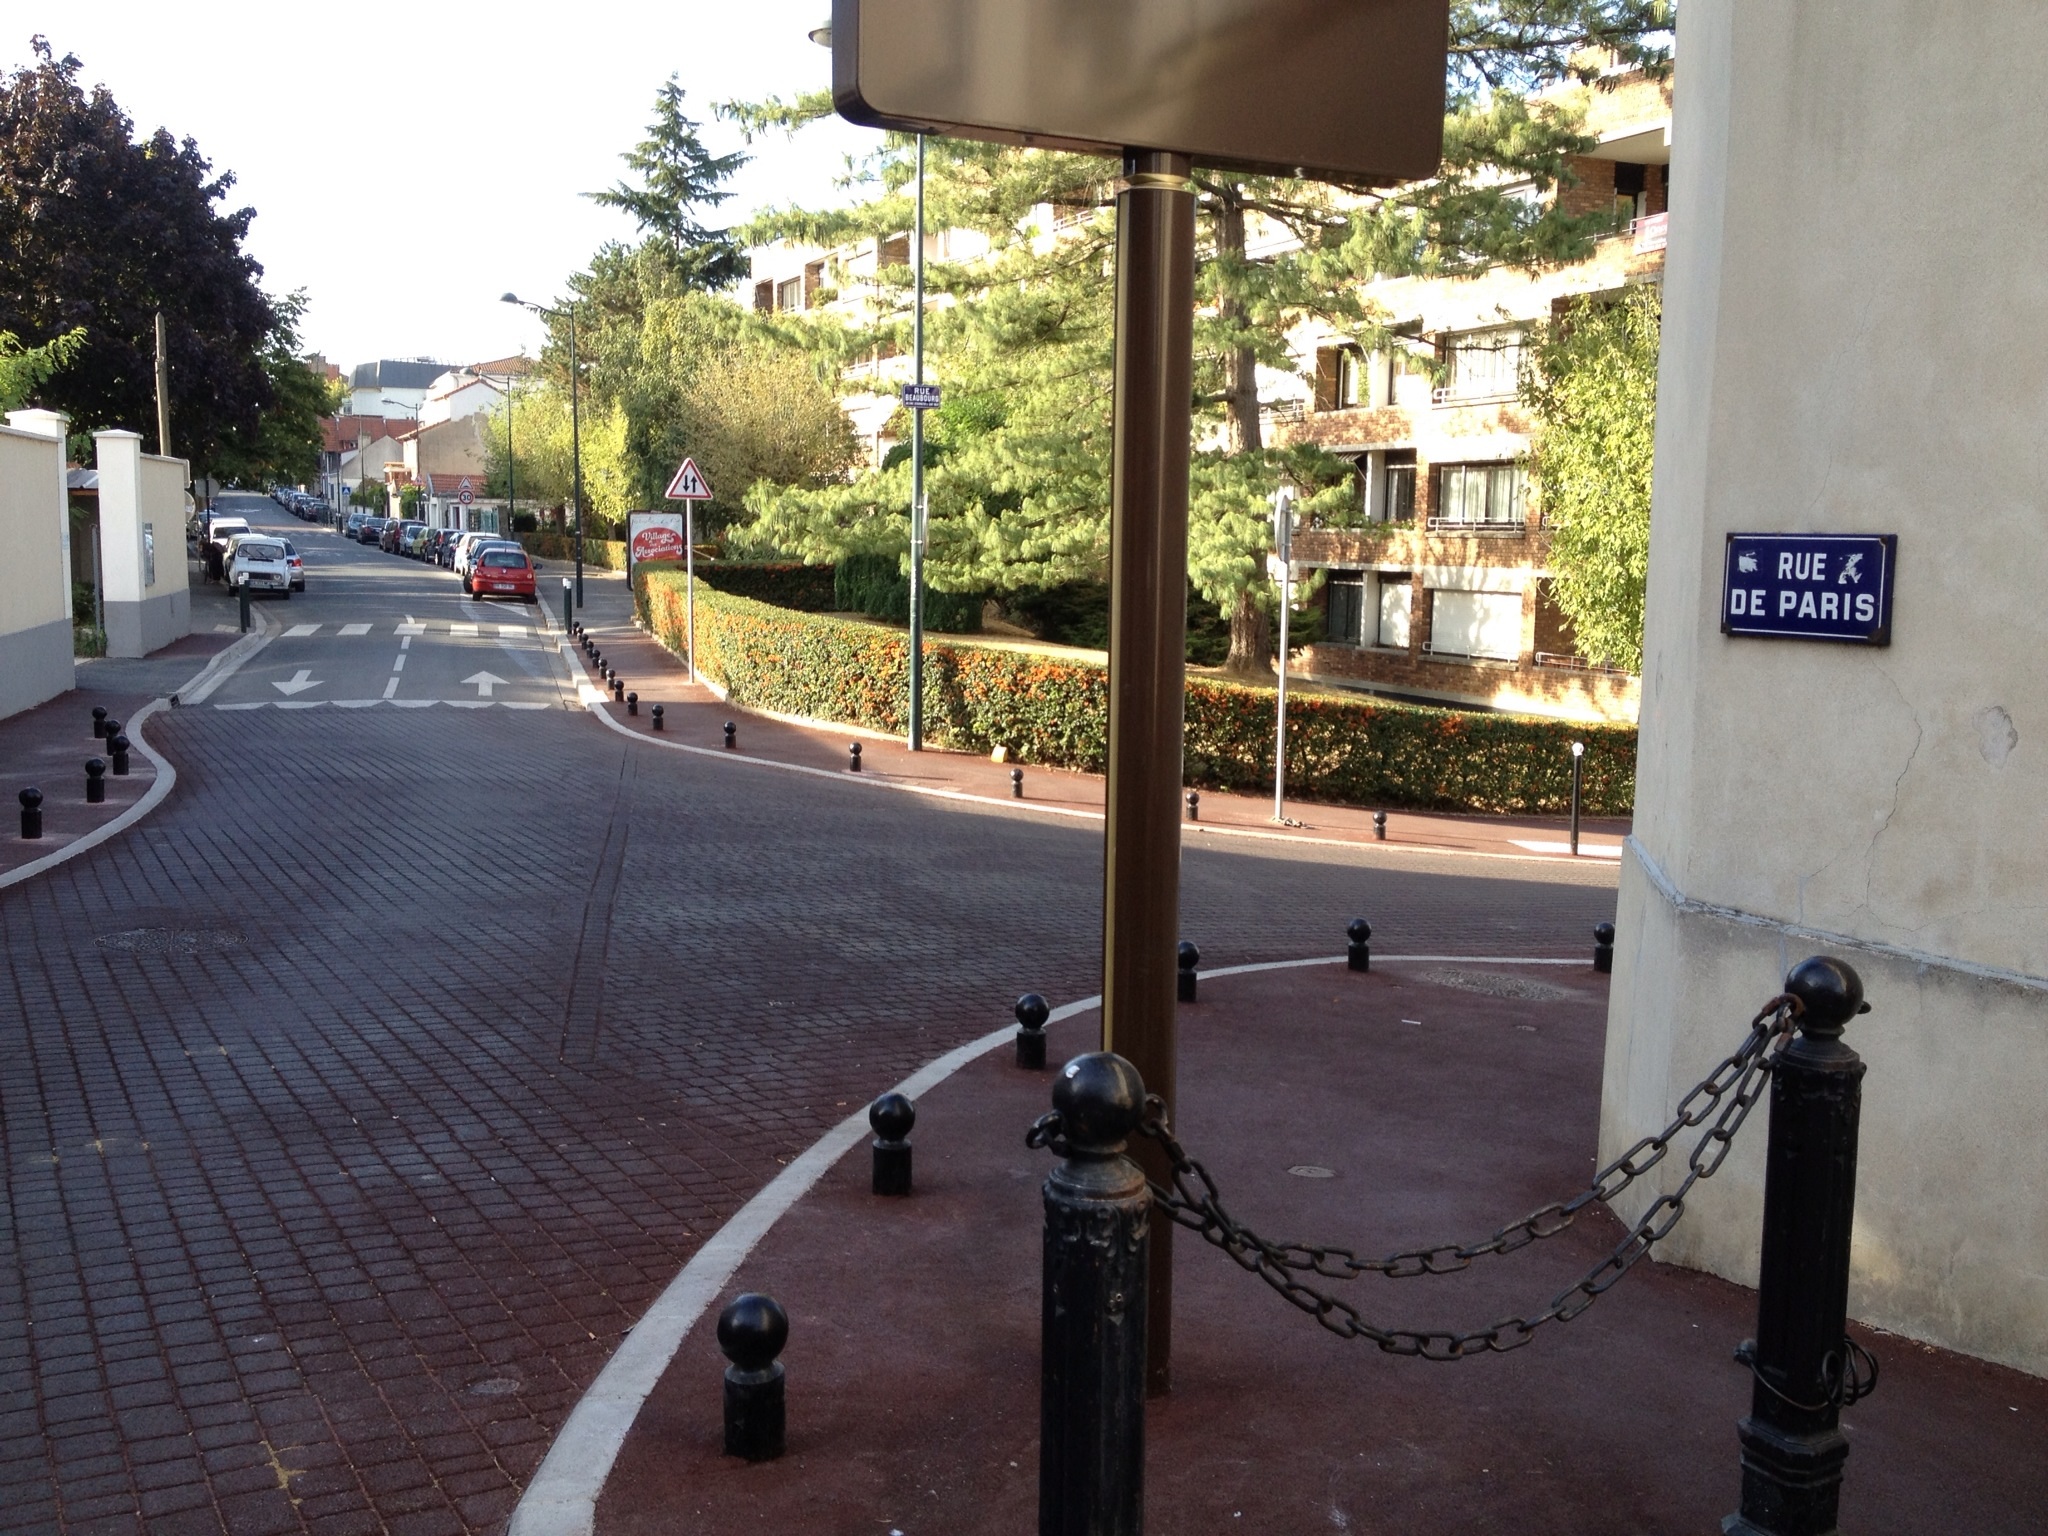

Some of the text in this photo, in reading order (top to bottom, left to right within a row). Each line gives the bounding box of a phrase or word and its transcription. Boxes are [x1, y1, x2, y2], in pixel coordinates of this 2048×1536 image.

[905, 393, 939, 402] BEAUBOURG
[914, 387, 930, 395] RUE
[1778, 552, 1827, 581] RUE
[1730, 588, 1875, 622] DE PARIS
